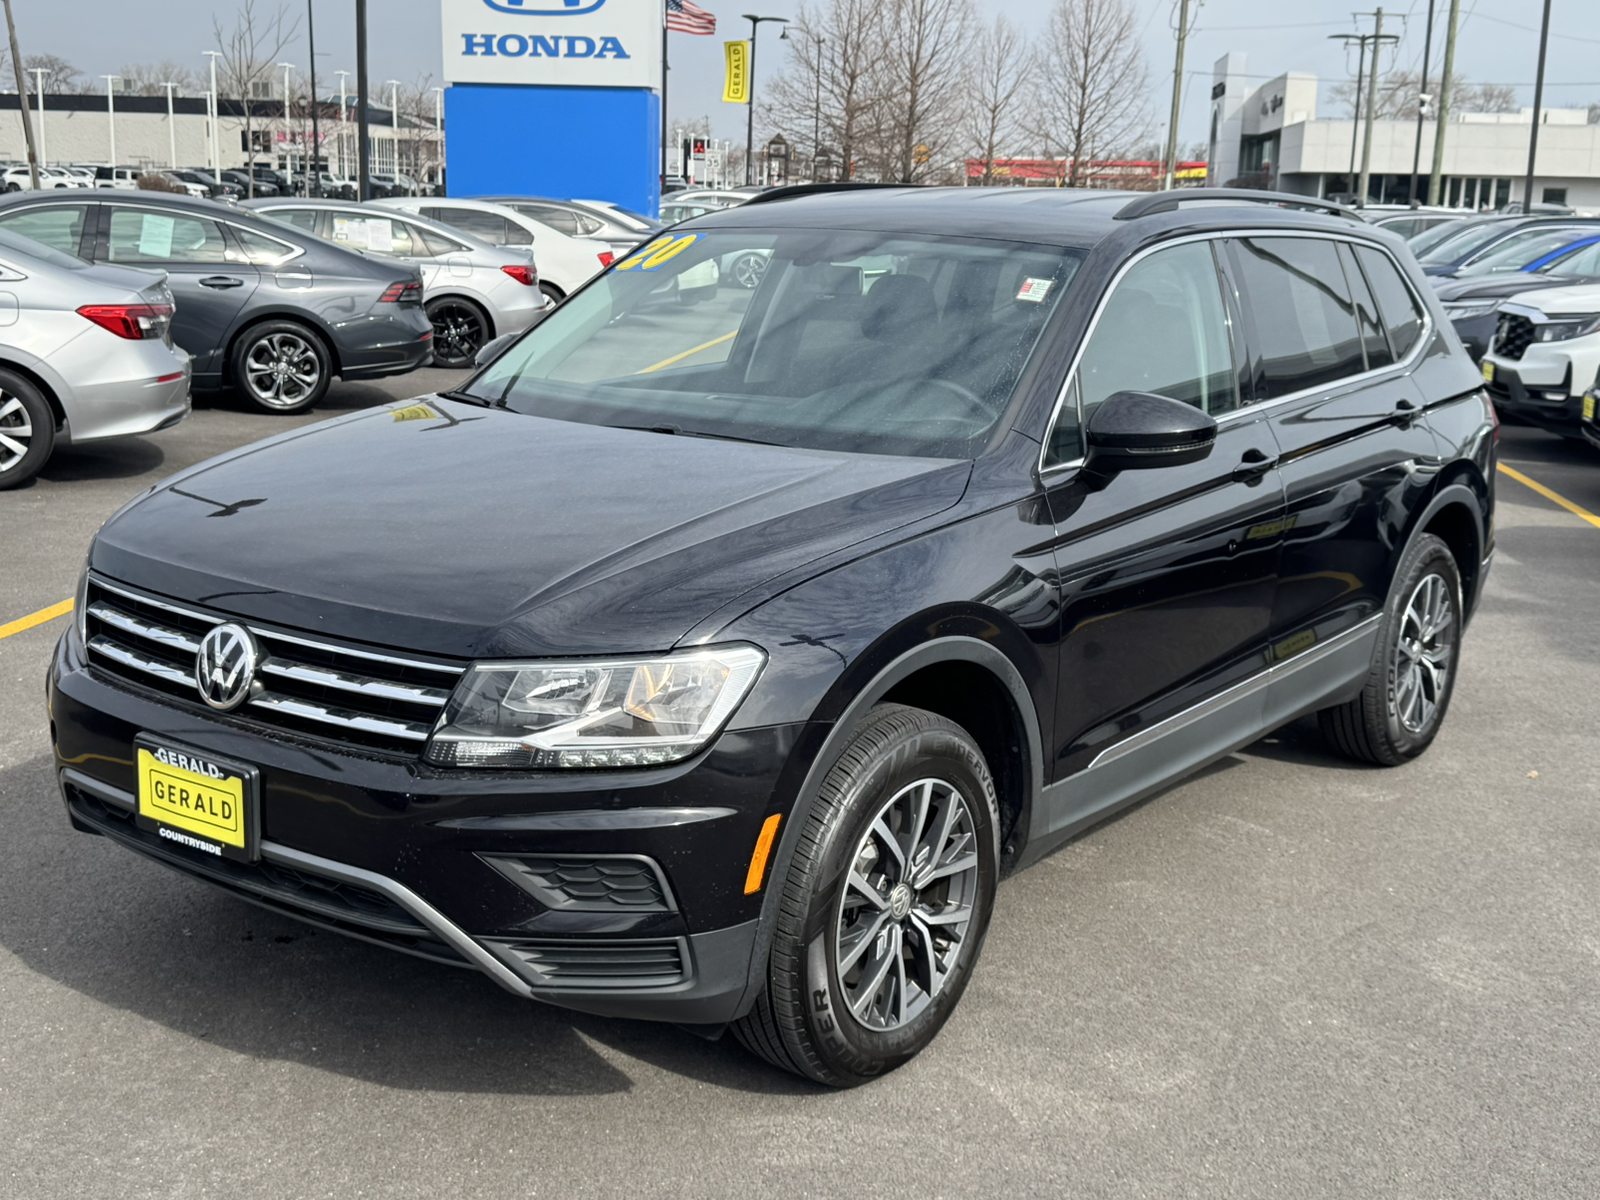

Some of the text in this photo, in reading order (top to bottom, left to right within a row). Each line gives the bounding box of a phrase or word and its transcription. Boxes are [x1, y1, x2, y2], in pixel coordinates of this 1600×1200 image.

[461, 33, 631, 59] HONDA
[732, 48, 741, 95] GERALD
[707, 159, 720, 168] 35
[616, 234, 697, 270] 20
[156, 747, 219, 779] GERALD
[155, 780, 232, 820] GERALD
[159, 827, 222, 856] COUNTRYSIDE
